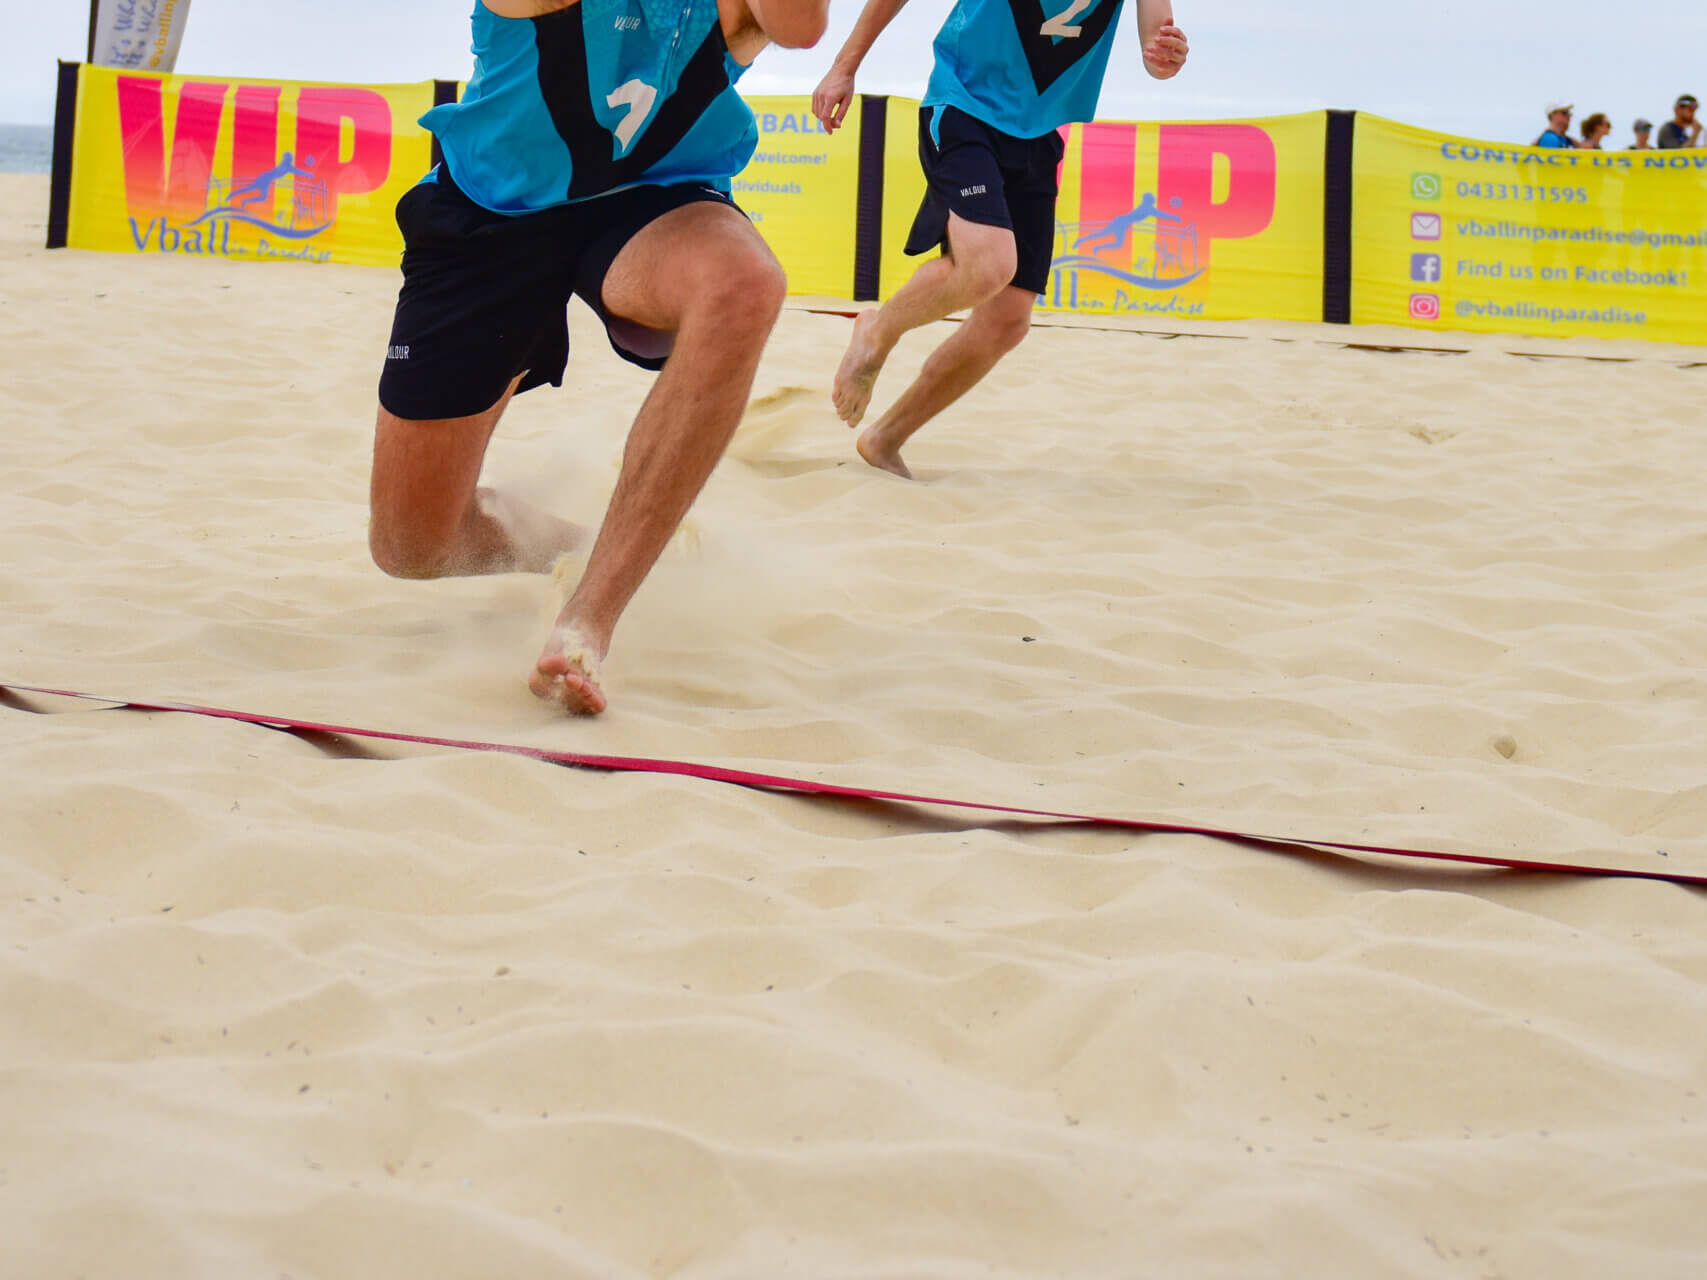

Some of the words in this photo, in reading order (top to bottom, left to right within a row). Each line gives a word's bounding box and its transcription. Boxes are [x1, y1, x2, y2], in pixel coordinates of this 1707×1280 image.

[755, 113, 828, 134] BALL
[117, 75, 392, 245] VIP
[753, 151, 828, 166] Welcome!
[1441, 142, 1584, 167] CONTACT
[1592, 156, 1632, 169] US
[731, 179, 803, 195] dividuals
[960, 184, 987, 197] VALOUR
[1456, 181, 1588, 204] 0433131595
[1056, 123, 1276, 308] IP
[128, 216, 230, 255] Vball
[230, 241, 248, 255] in
[256, 238, 333, 262] Paradise
[1456, 260, 1503, 278] Find
[1509, 264, 1534, 280] us
[1540, 266, 1568, 281] on
[1574, 265, 1688, 287] Facebook!
[1080, 292, 1105, 309] in
[1113, 288, 1206, 314] Paradise
[1454, 298, 1648, 325] @vballinparadise
